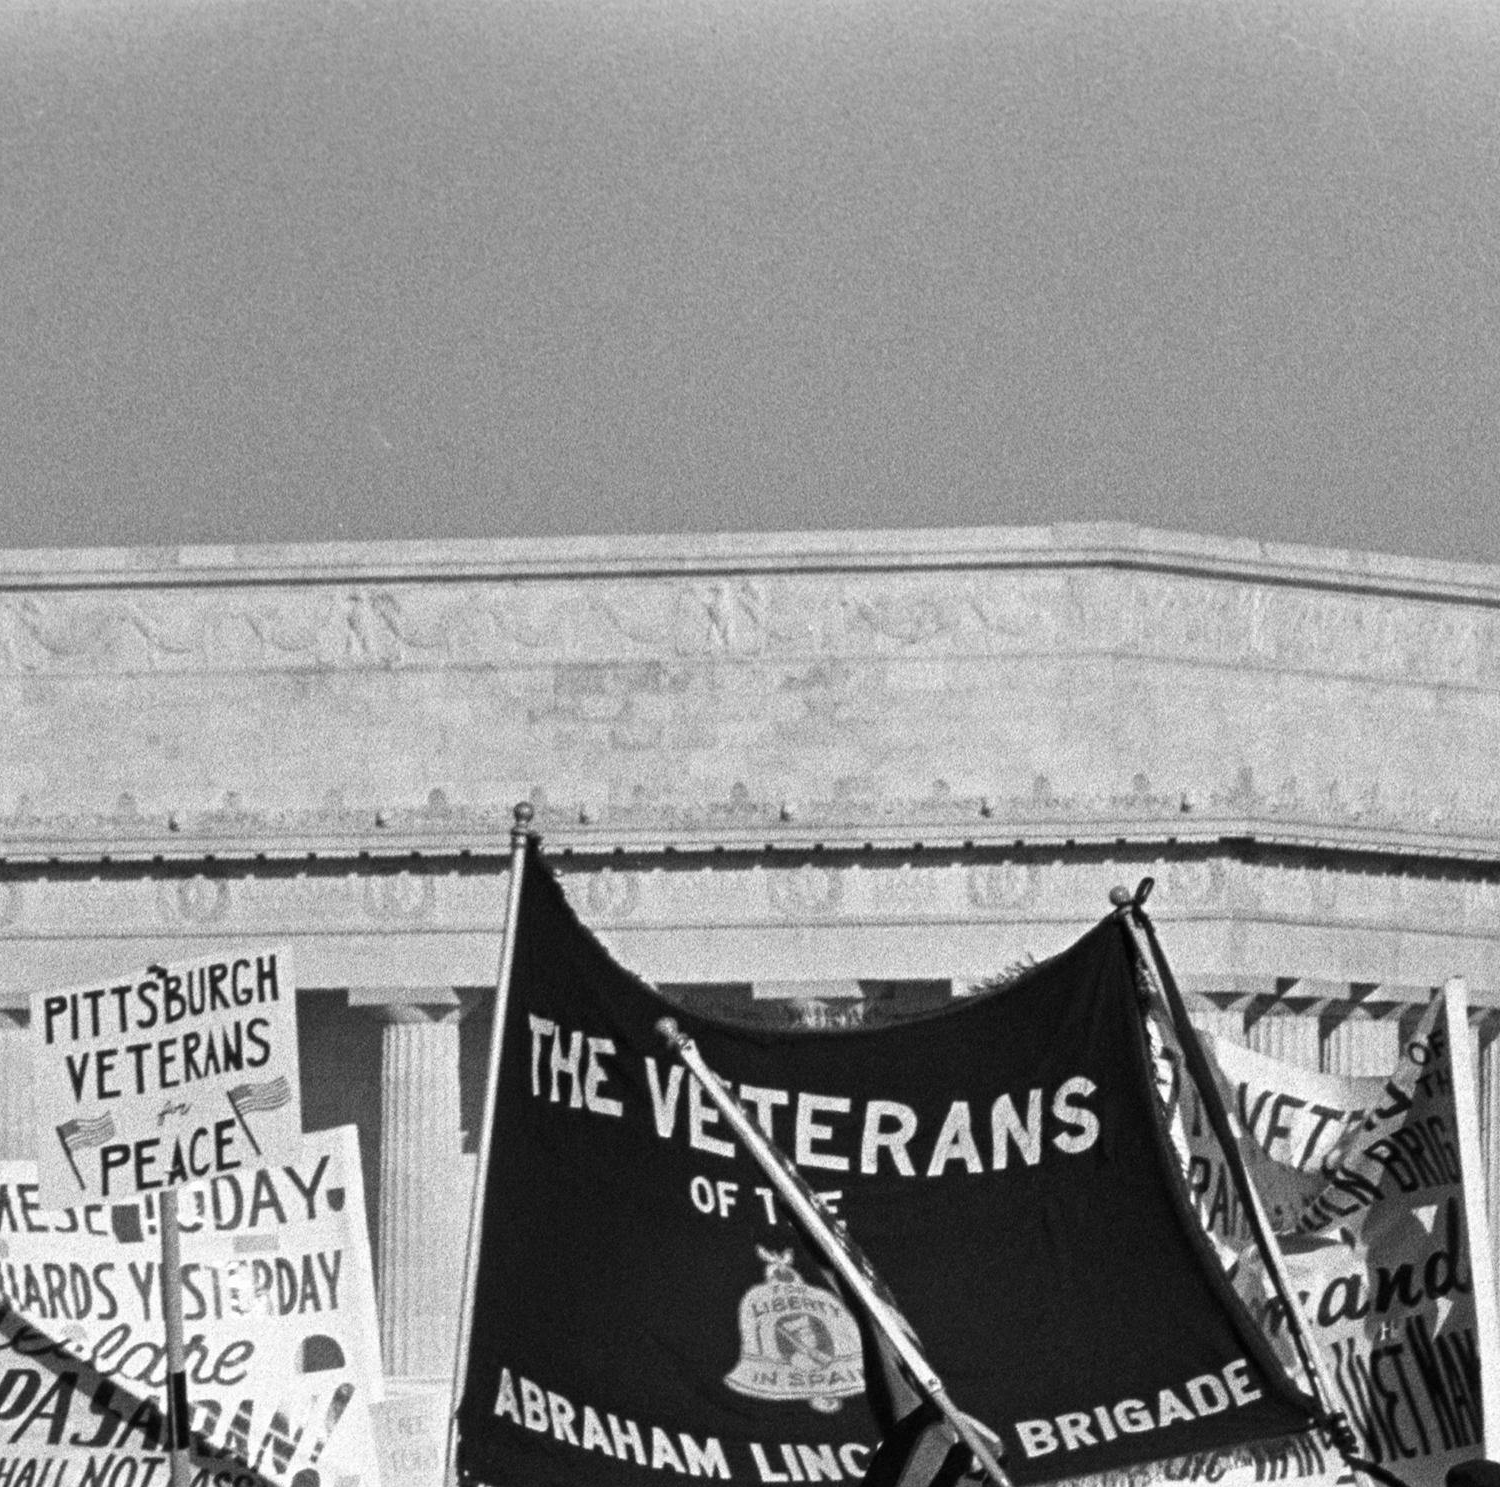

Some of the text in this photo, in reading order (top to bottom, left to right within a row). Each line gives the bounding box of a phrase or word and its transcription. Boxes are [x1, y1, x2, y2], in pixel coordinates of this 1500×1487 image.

[44, 954, 279, 1044] PITTSBURGH
[65, 1017, 271, 1103] VETERANS
[1408, 1029, 1443, 1068] OF
[1415, 1070, 1453, 1098] TH
[528, 1012, 624, 1118] THE
[645, 1056, 1100, 1177] VETERANS
[100, 1118, 242, 1197] PEACE
[1363, 1114, 1463, 1194] BRIG
[689, 1175, 848, 1236] OF TE
[127, 1250, 342, 1323] YSTRDAY
[1317, 1196, 1475, 1329] and
[750, 1296, 841, 1318] LIBERTY
[752, 1369, 860, 1388] IN SPAI
[493, 1367, 731, 1481] ABRAHAM
[750, 1441, 884, 1484] LINC
[1014, 1358, 1263, 1460] BRIGADE
